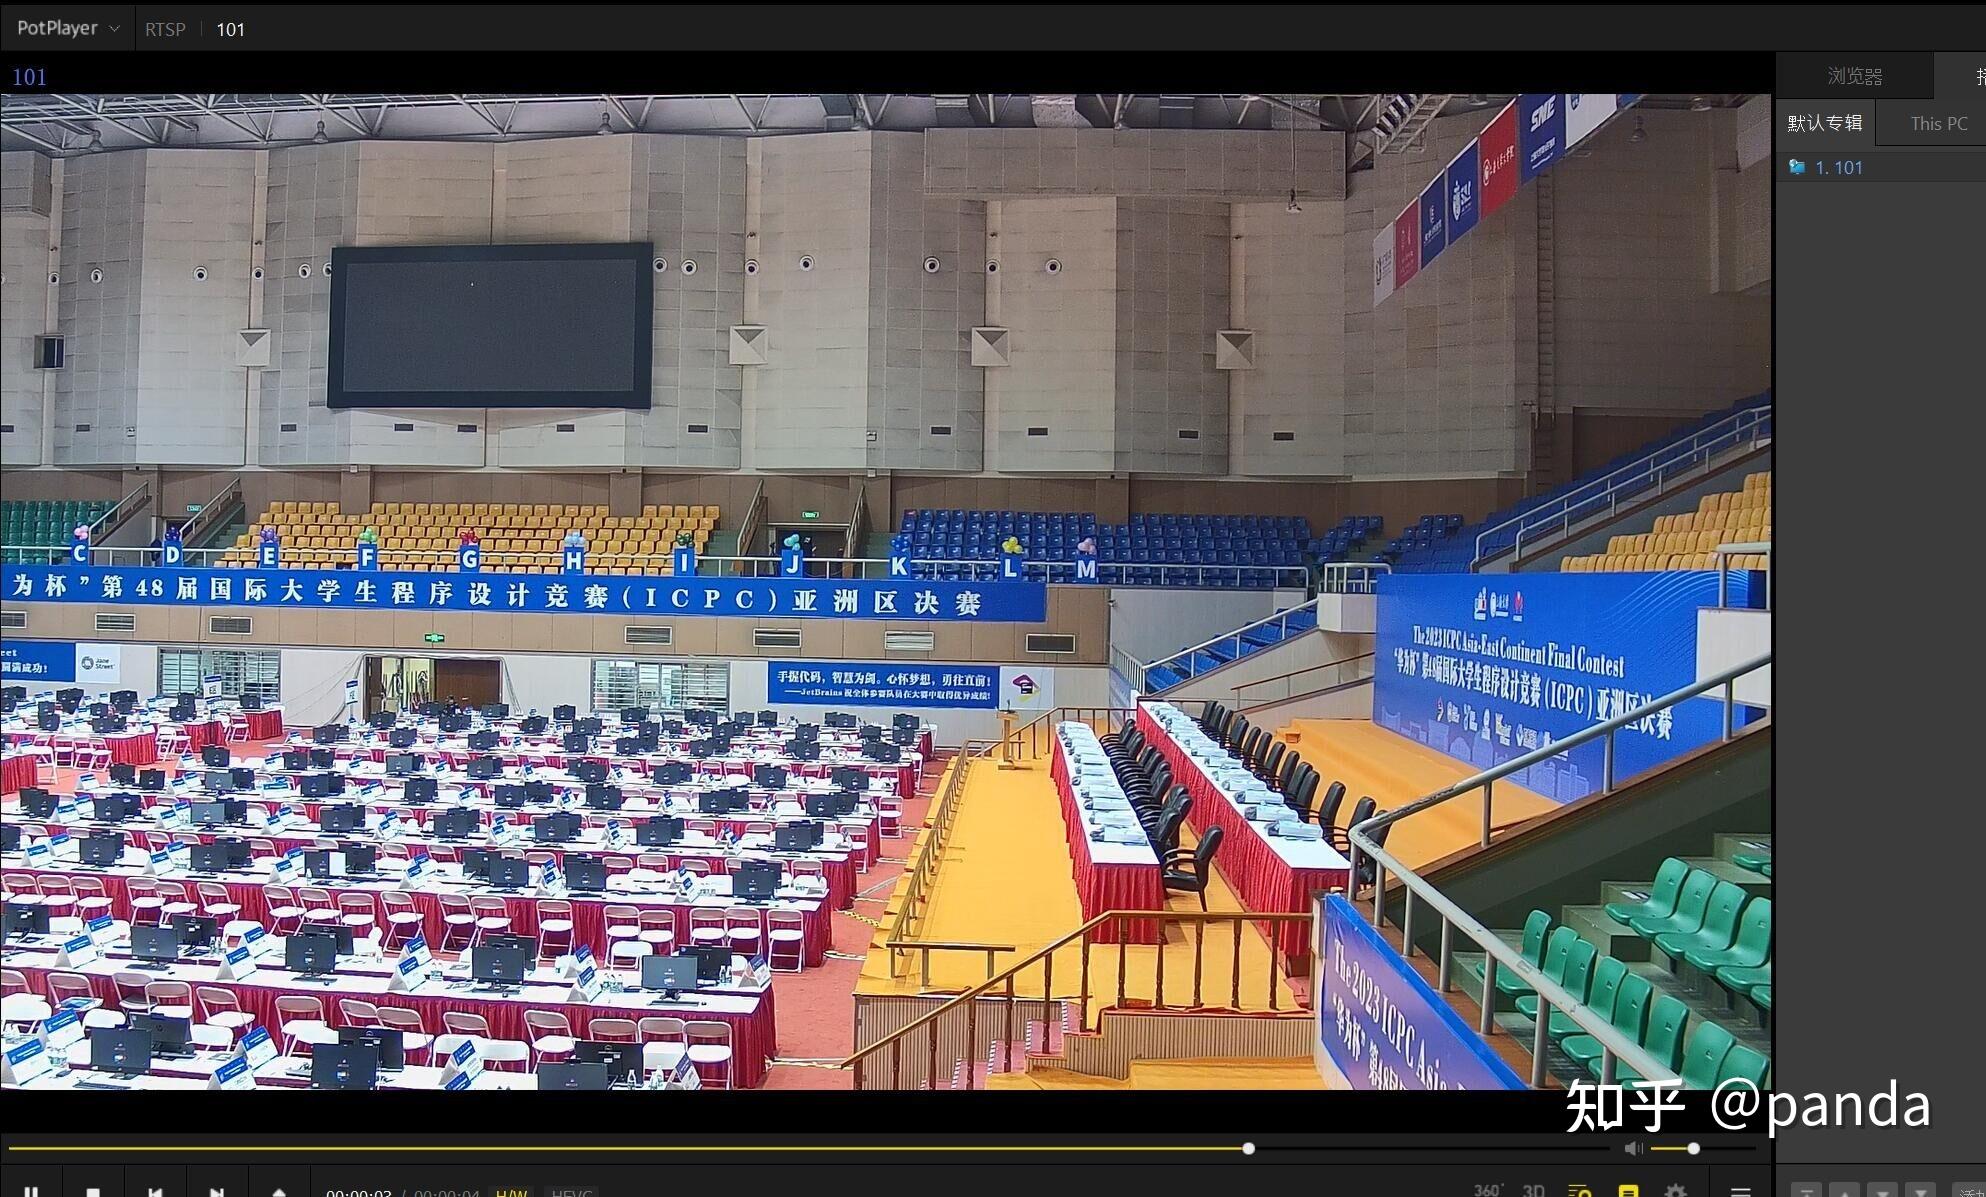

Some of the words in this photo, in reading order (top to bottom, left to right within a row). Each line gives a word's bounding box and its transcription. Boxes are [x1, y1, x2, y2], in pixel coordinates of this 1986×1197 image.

[18, 19, 99, 39] PotPlayer
[146, 22, 186, 37] RTSP
[217, 22, 245, 37] 101
[13, 68, 47, 86] 101
[1828, 66, 1883, 86] 浏览器
[1787, 113, 1863, 133] 默认专辑
[1911, 116, 1942, 131] This
[1947, 116, 1968, 131] PC
[1816, 160, 1829, 175] 1.
[1835, 160, 1862, 175] 101
[74, 544, 86, 562] C
[166, 546, 180, 563] D
[263, 547, 275, 564] E
[363, 549, 374, 567] F
[462, 550, 478, 568] G
[566, 552, 581, 570] H
[680, 553, 688, 572] I
[786, 555, 799, 574] J
[892, 556, 908, 575] K
[1004, 558, 1017, 578] L
[1077, 559, 1096, 579] M
[1413, 625, 1426, 645] The
[1426, 626, 1442, 648] 2023
[1442, 628, 1461, 650] ICPC
[1500, 636, 1546, 666] Continent
[1547, 642, 1576, 670] Final
[1577, 646, 1625, 679] Contest
[1334, 939, 1351, 988] The
[1353, 961, 1381, 1024] 2023
[1381, 995, 1416, 1069] ICPC
[1523, 1184, 1545, 1197] 3D
